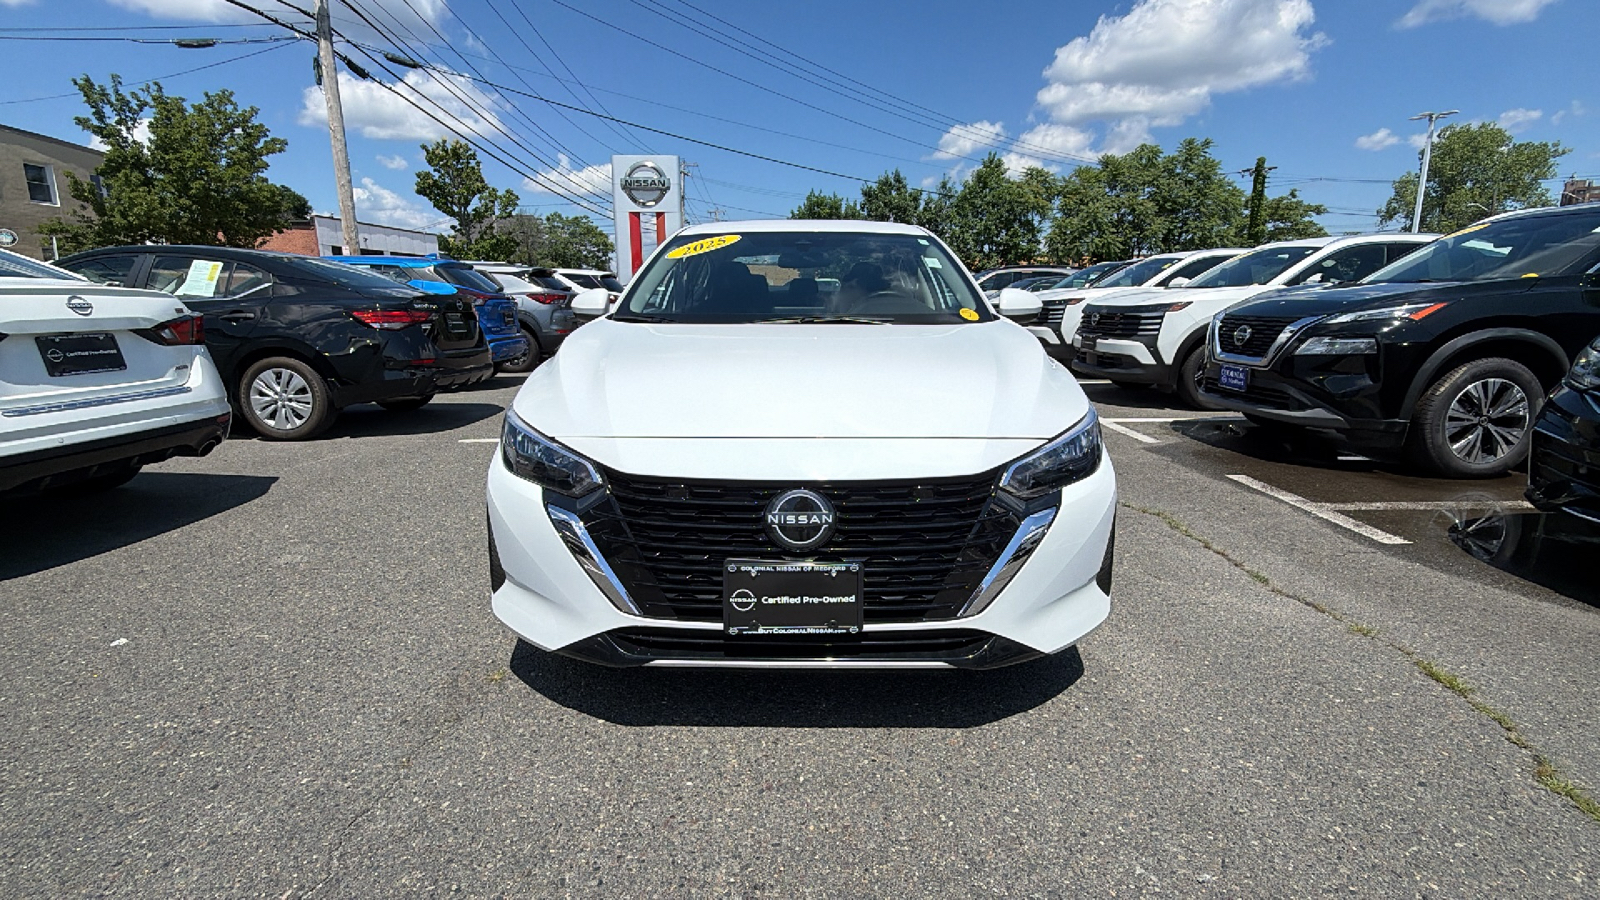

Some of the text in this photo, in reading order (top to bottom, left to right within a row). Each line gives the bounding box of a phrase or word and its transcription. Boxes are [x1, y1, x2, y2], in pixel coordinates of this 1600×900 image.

[624, 179, 666, 187] NISSAN
[682, 237, 727, 255] 2025
[767, 514, 833, 524] NISSAN
[761, 595, 856, 604] Certified Pre-Owned
